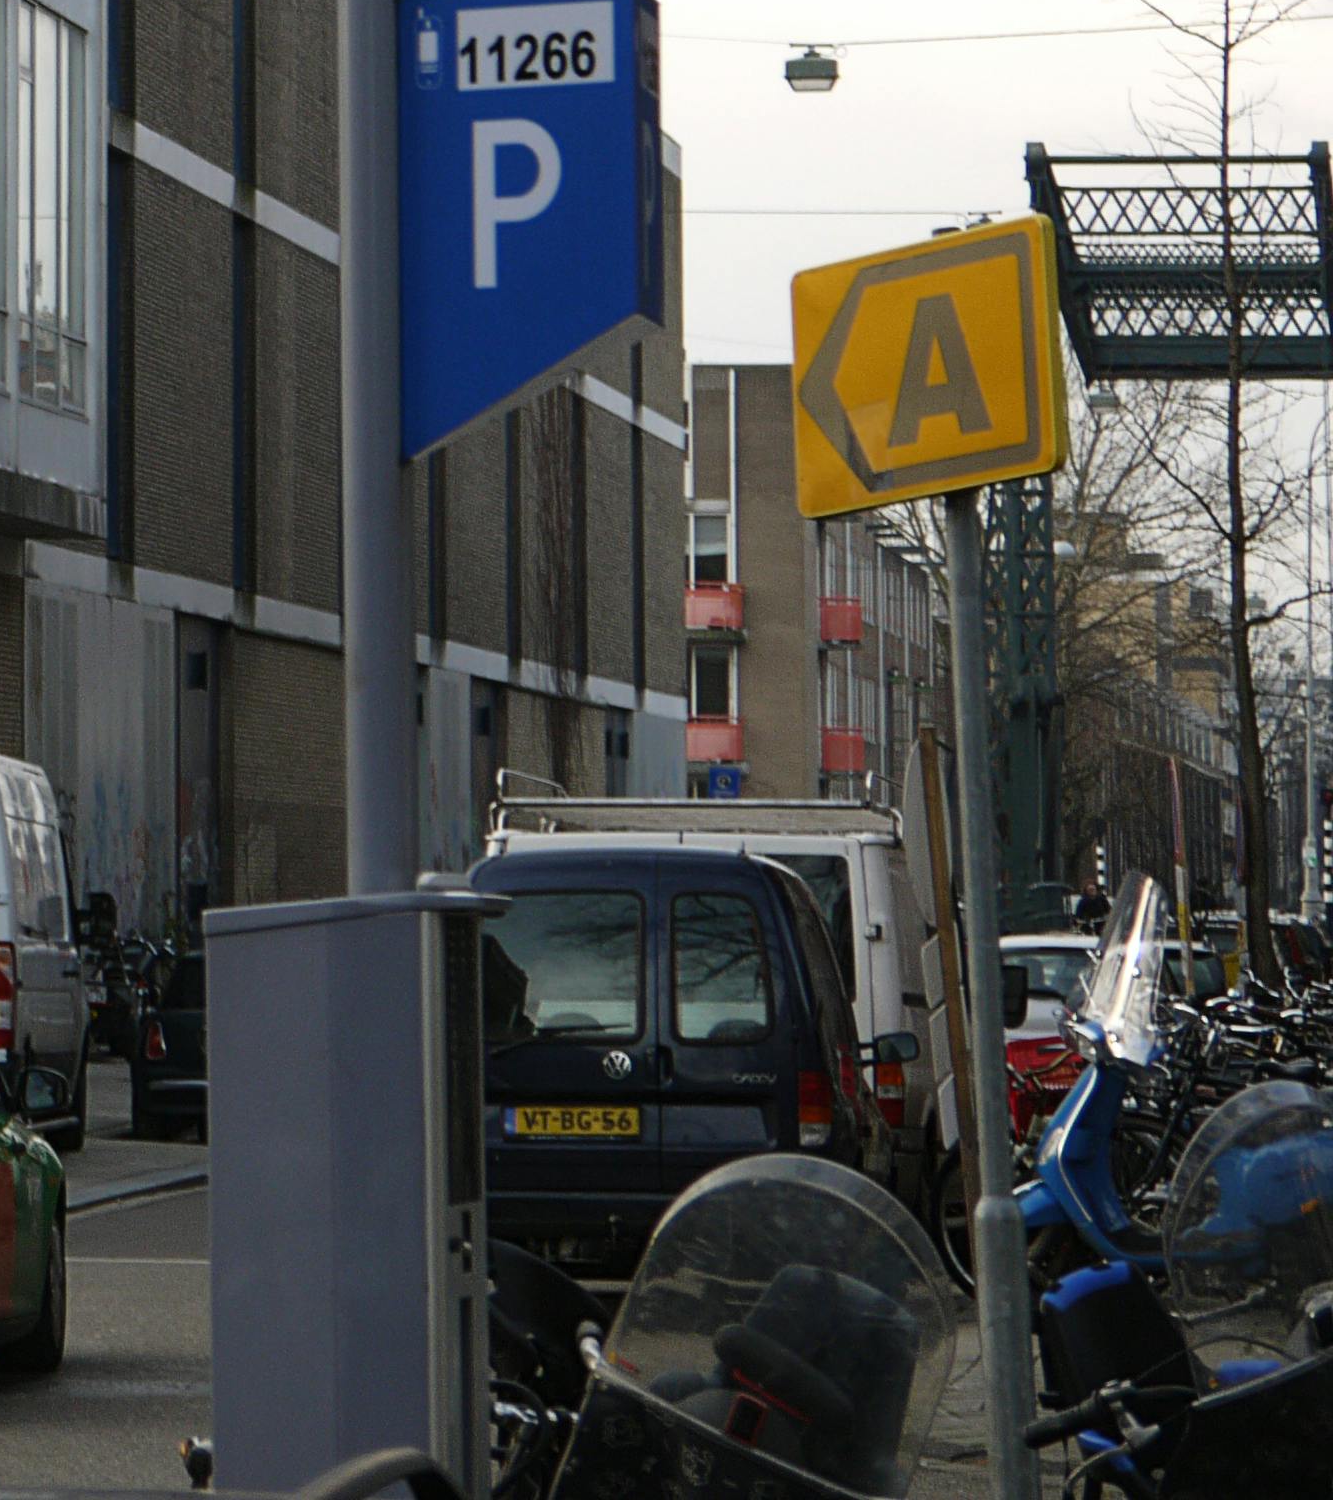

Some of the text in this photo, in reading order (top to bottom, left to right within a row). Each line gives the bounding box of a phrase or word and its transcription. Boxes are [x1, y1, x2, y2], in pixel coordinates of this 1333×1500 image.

[460, 30, 597, 85] 11266
[472, 118, 562, 289] P
[887, 292, 993, 448] A
[523, 1111, 631, 1131] VT-BG-56
